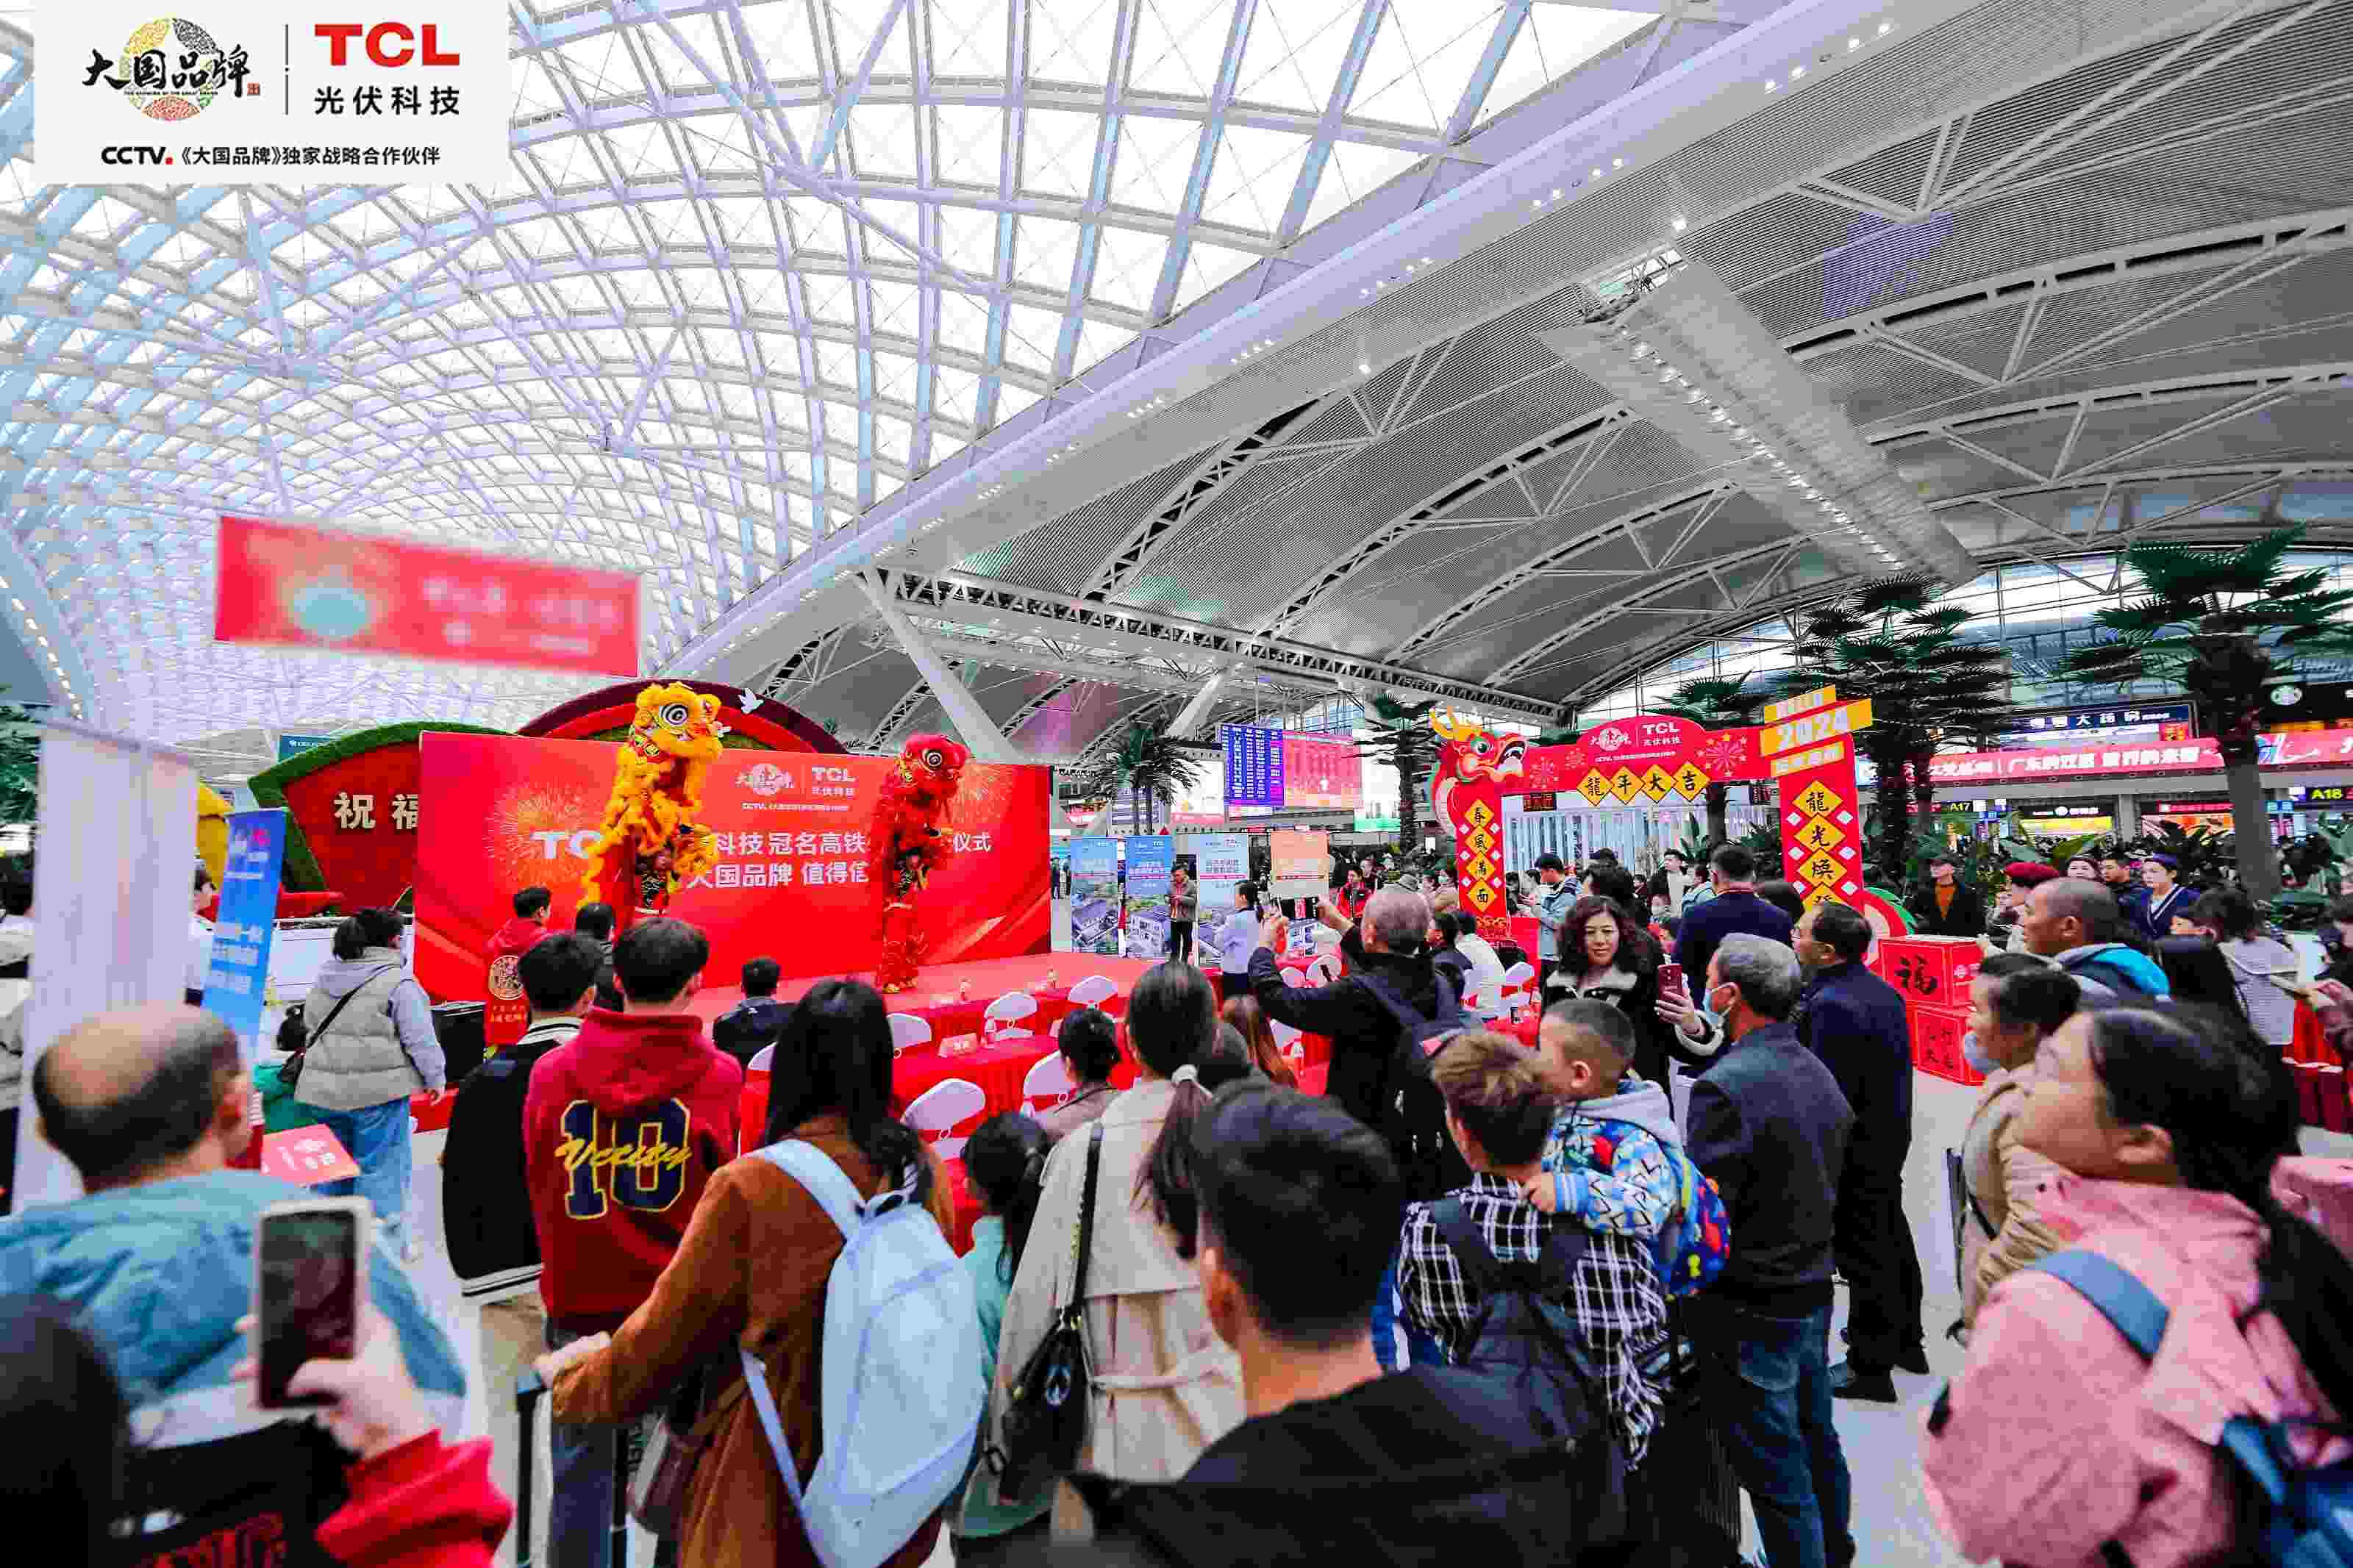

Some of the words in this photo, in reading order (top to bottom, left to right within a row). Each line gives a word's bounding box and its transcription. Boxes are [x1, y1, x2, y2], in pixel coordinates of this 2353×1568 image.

[1642, 723, 1680, 734] TCL
[811, 766, 856, 782] TCL
[1585, 770, 1697, 795] 龍年大吉
[2311, 788, 2343, 800] A18
[716, 831, 867, 856] 科技冠名高铁
[952, 831, 993, 853] 仪式
